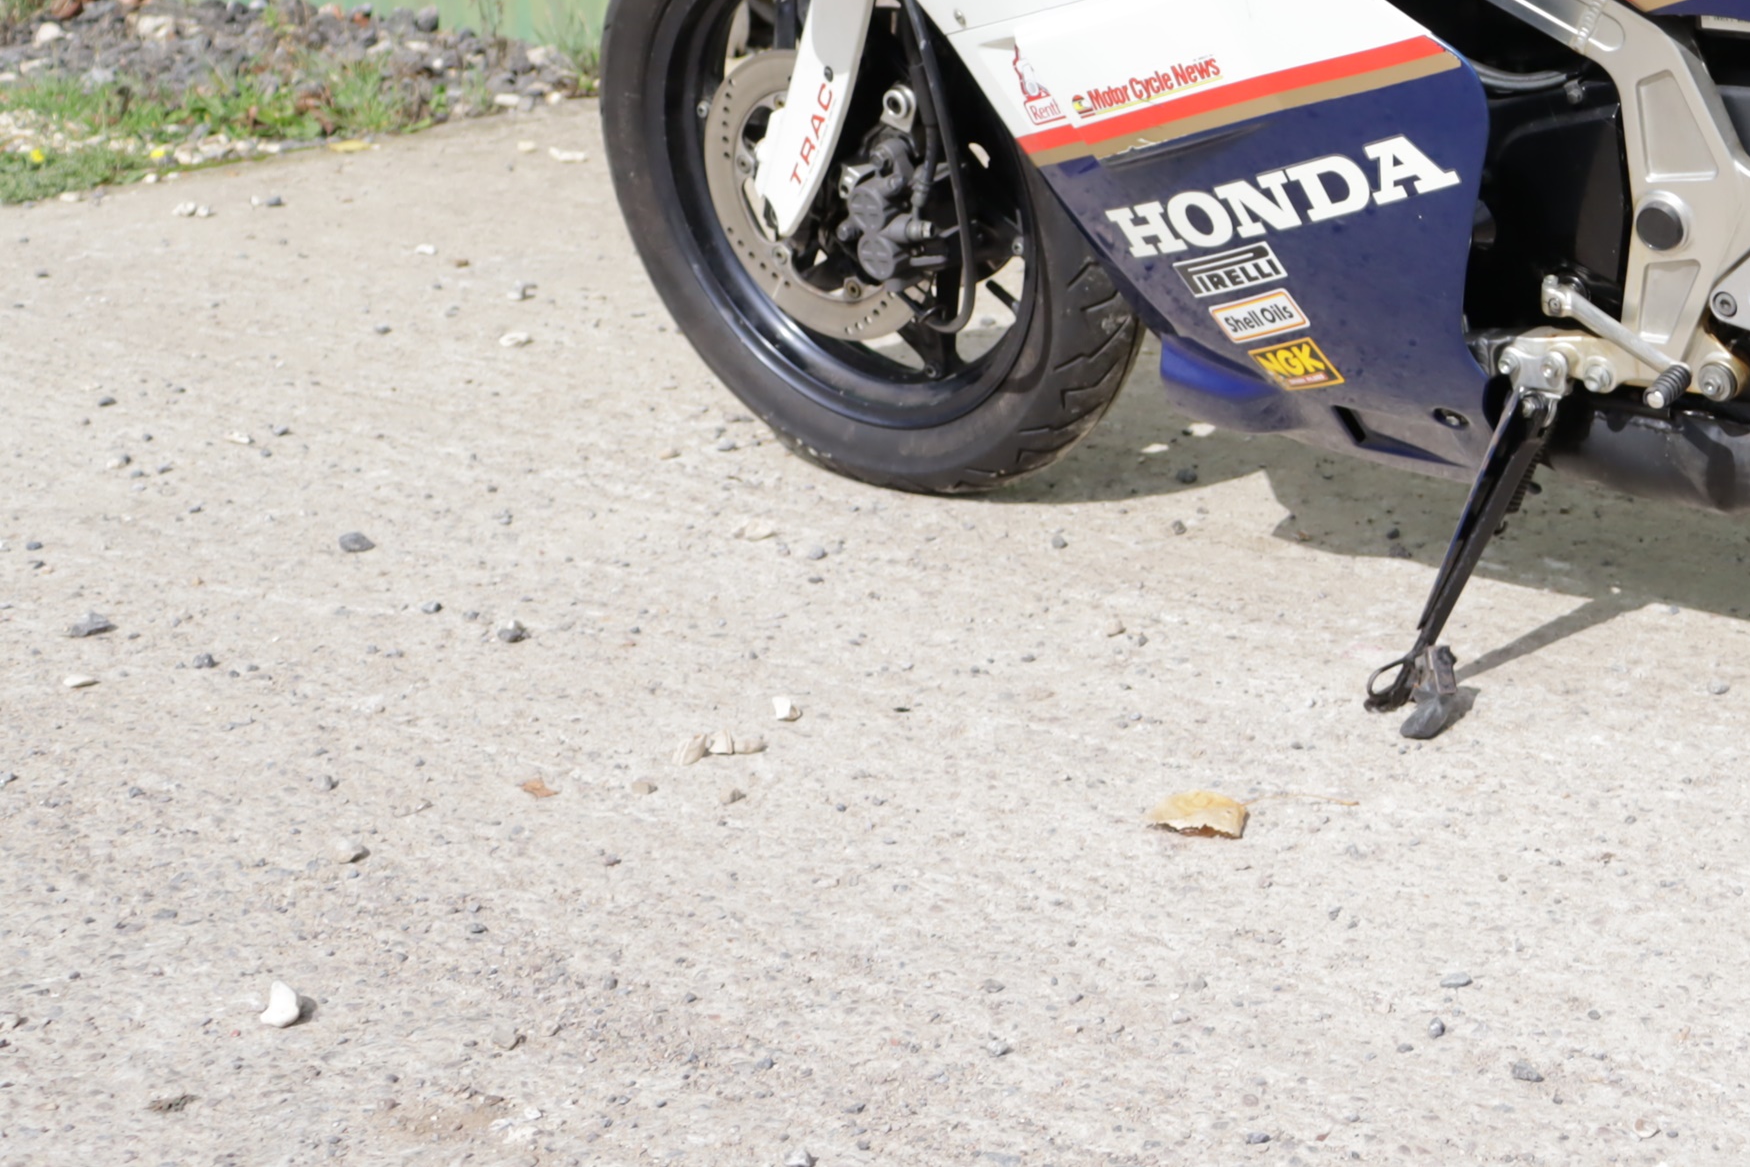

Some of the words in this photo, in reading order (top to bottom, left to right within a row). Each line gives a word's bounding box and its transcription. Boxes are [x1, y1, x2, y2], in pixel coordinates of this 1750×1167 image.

[1087, 83, 1131, 112] Motor
[1128, 70, 1174, 101] Cycle
[1170, 56, 1222, 85] News
[789, 82, 833, 185] TRAC
[1104, 134, 1462, 259] HONDA
[1174, 244, 1282, 295] PIRELLI
[1223, 310, 1264, 333] Shell
[1260, 303, 1295, 325] Oils
[1255, 343, 1326, 379] NGK
